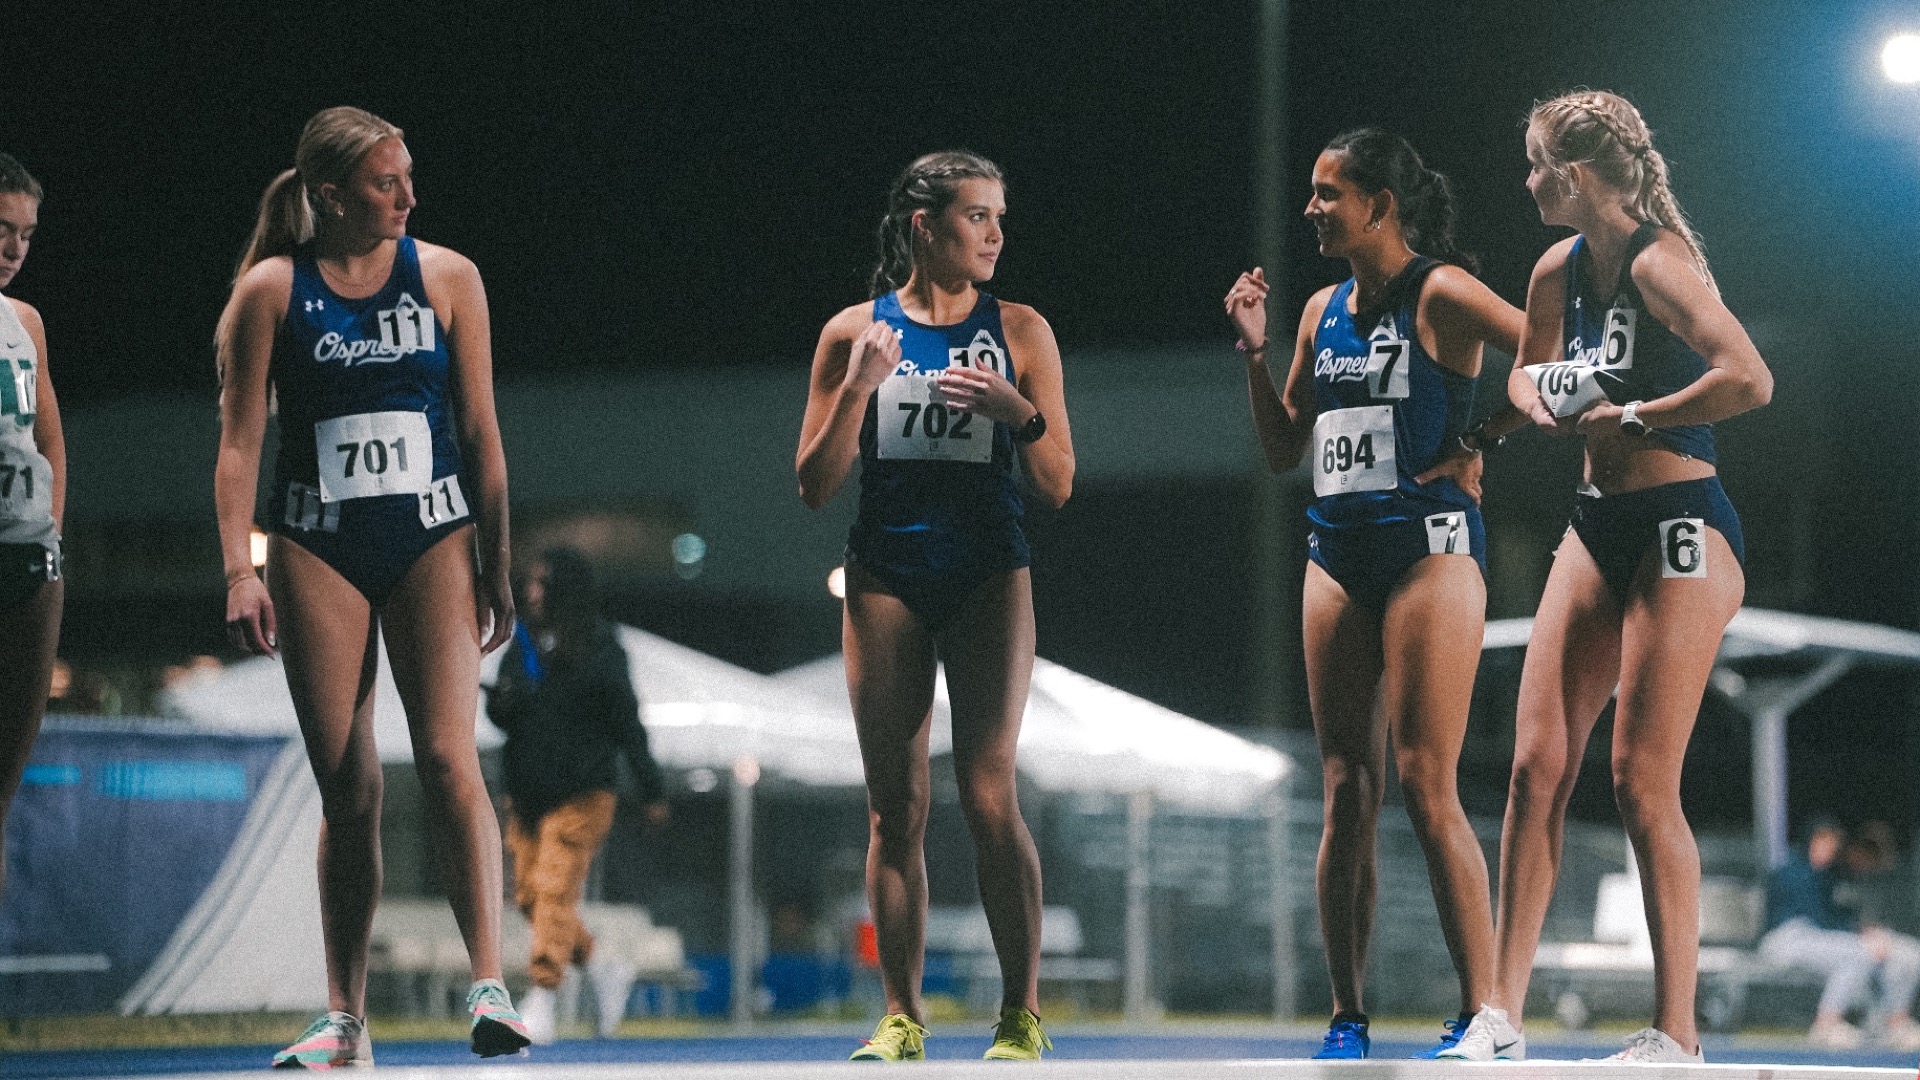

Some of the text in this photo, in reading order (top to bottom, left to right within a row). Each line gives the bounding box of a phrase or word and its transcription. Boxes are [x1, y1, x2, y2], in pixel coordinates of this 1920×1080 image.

[383, 310, 424, 347] 11
[1605, 313, 1628, 366] 6
[1375, 344, 1403, 395] 7
[1537, 364, 1586, 396] 705
[898, 402, 973, 440] 702
[336, 436, 409, 479] 701
[1322, 433, 1376, 475] 694
[423, 480, 457, 524] 11
[1431, 515, 1461, 554] 7
[1667, 521, 1700, 573] 6
